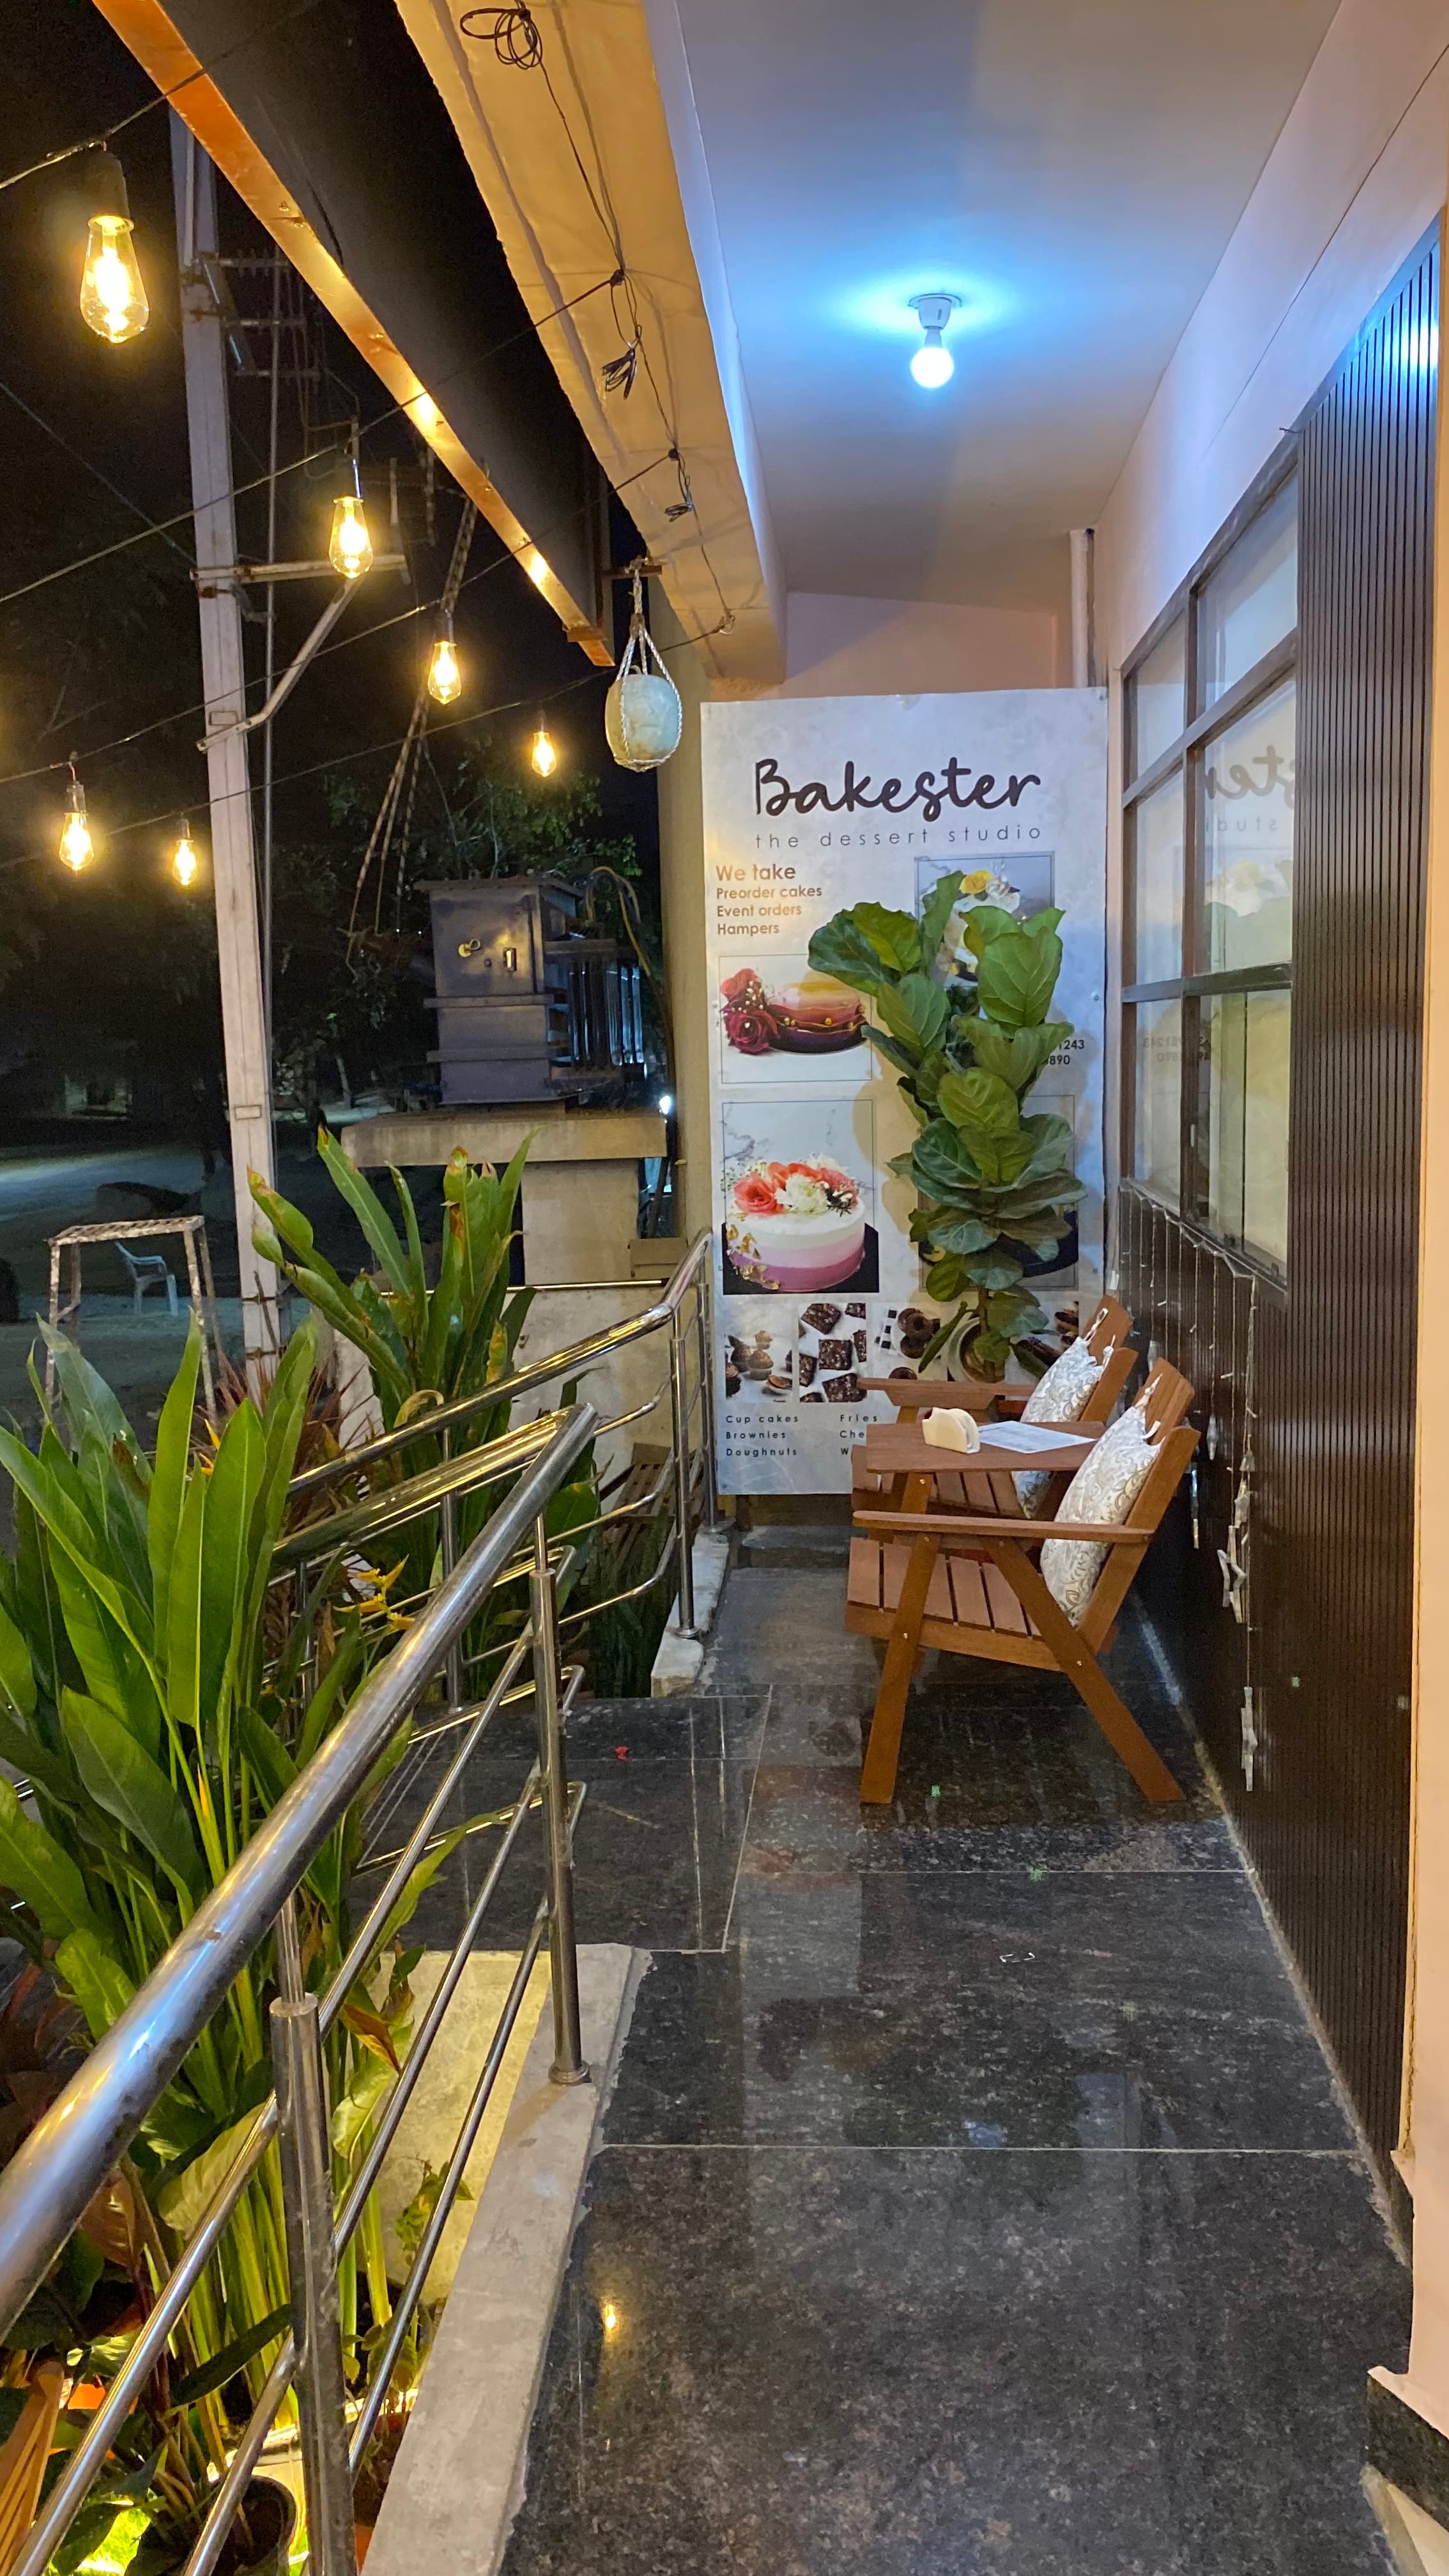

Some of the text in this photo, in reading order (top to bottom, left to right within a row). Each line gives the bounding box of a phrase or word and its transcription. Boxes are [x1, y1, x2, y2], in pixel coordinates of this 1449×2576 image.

[755, 756, 1041, 822] Bakester
[755, 824, 1041, 849] the dessert studio
[716, 863, 796, 881] We take
[716, 885, 822, 900] Preorder cakes
[717, 904, 802, 917] Event orders
[717, 923, 779, 937] Hampers
[1059, 1039, 1085, 1050] 1243
[1046, 1055, 1070, 1065] 890
[726, 1414, 799, 1425] Cup cakes
[839, 1414, 878, 1422] Fries
[726, 1431, 786, 1439] Brownies
[839, 1430, 864, 1438] Che
[726, 1447, 797, 1457] Doughnuts
